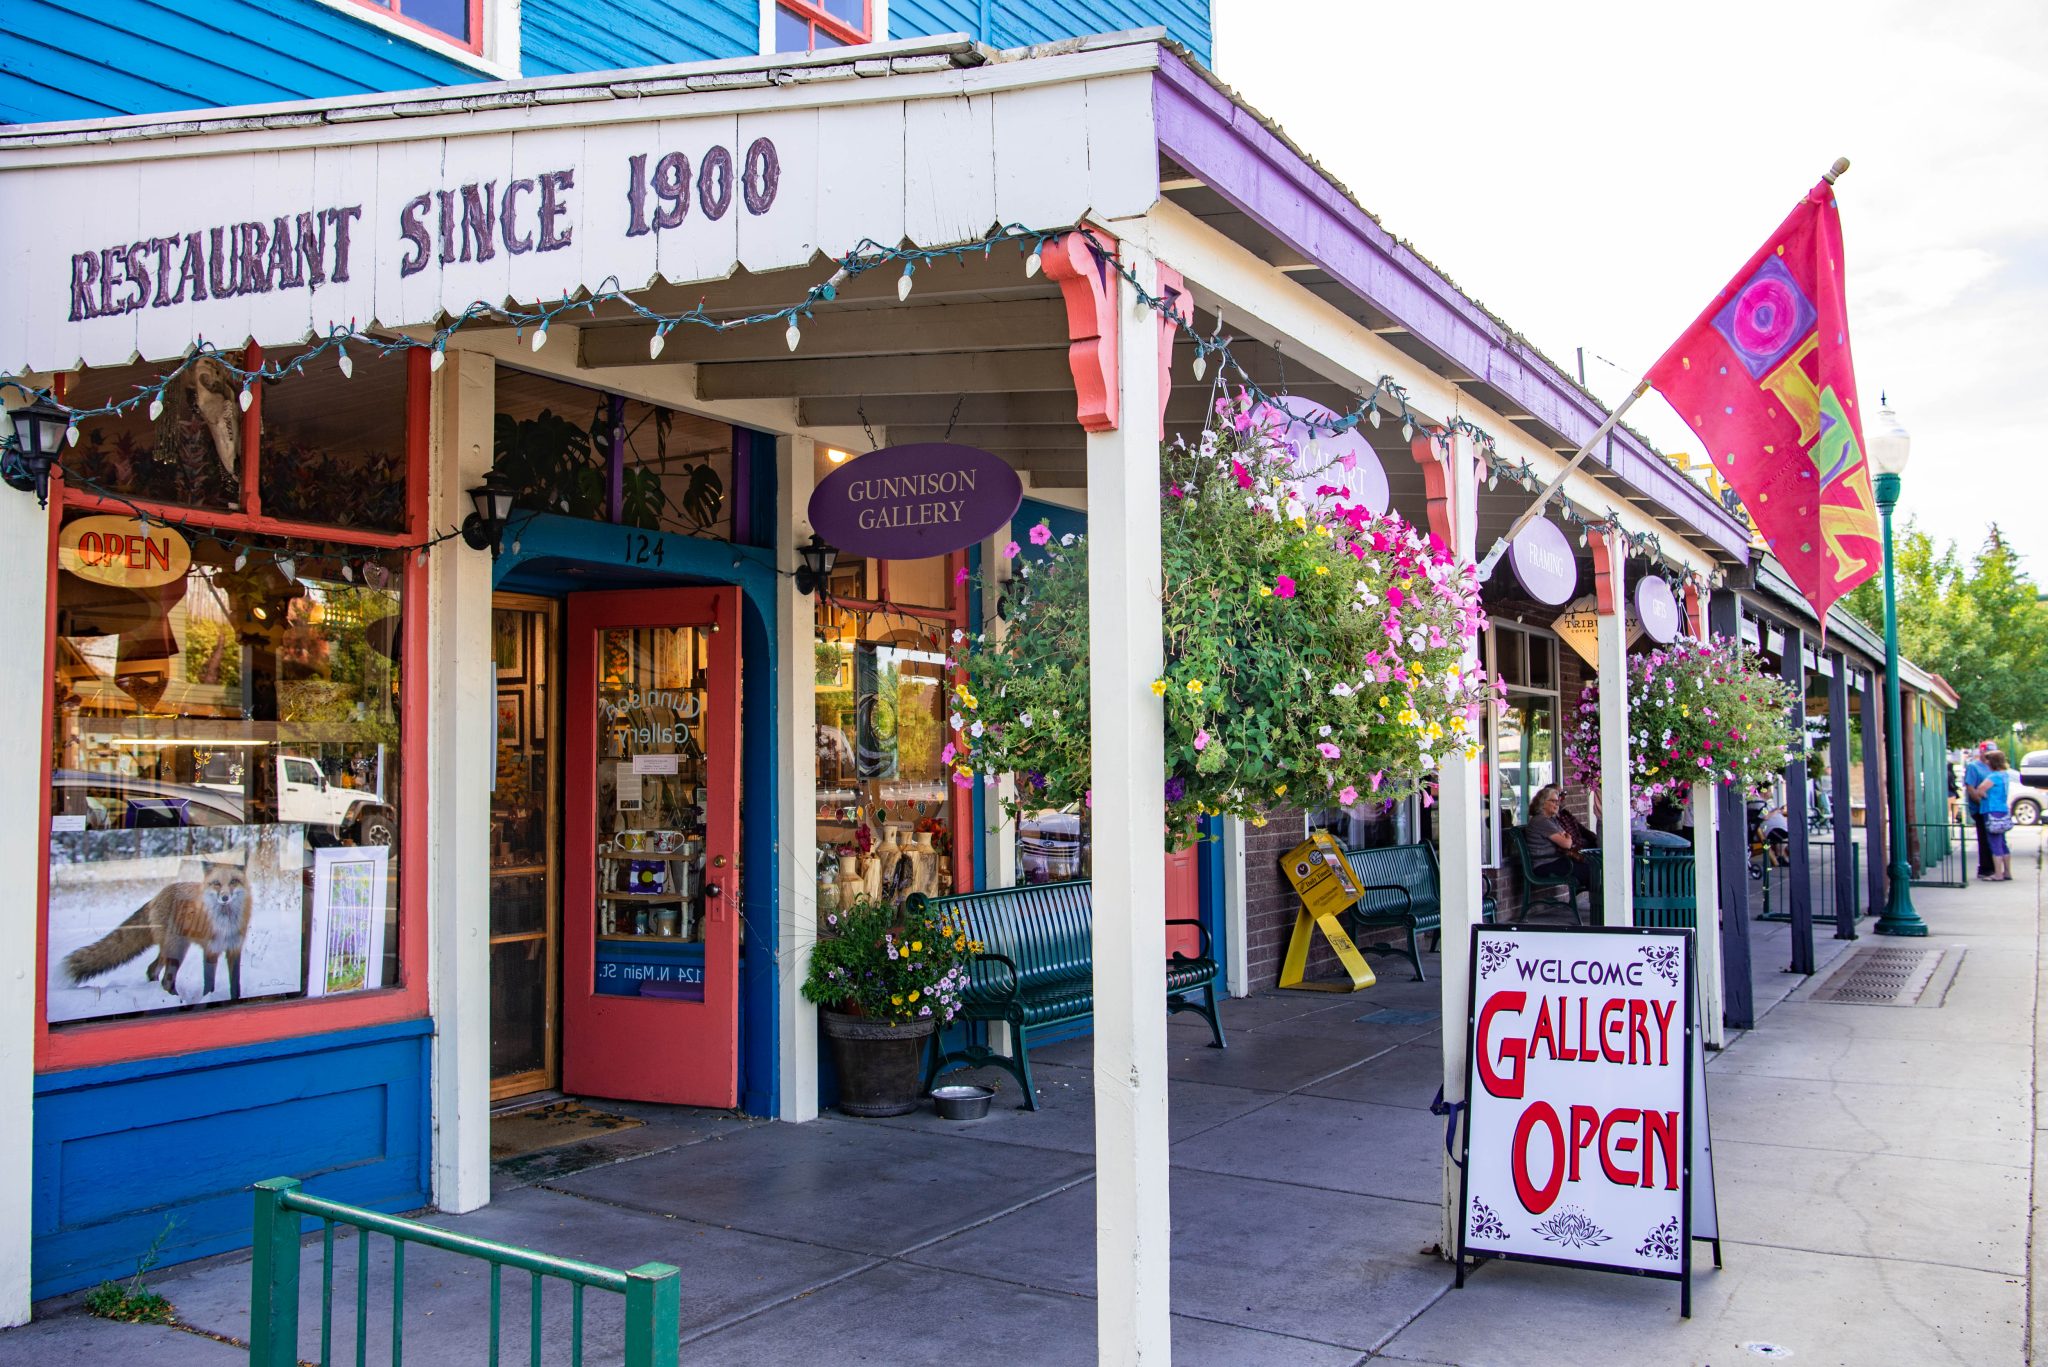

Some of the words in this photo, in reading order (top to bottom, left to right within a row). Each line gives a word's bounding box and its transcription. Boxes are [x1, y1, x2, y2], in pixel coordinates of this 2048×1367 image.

[68, 204, 363, 323] RESTAURANT
[399, 168, 576, 279] SINCE
[625, 136, 782, 238] 1900
[848, 468, 978, 502] GUNNISON
[1336, 455, 1367, 496] ART
[858, 500, 966, 530] GALLERY
[78, 531, 169, 571] OPEN
[625, 533, 664, 567] 124
[1529, 542, 1563, 577] FRAMING
[1565, 619, 1638, 629] TRIBRY
[1516, 958, 1644, 986] WELCOME
[1476, 991, 1677, 1099] GALLERY
[1511, 1101, 1680, 1215] OPEN
